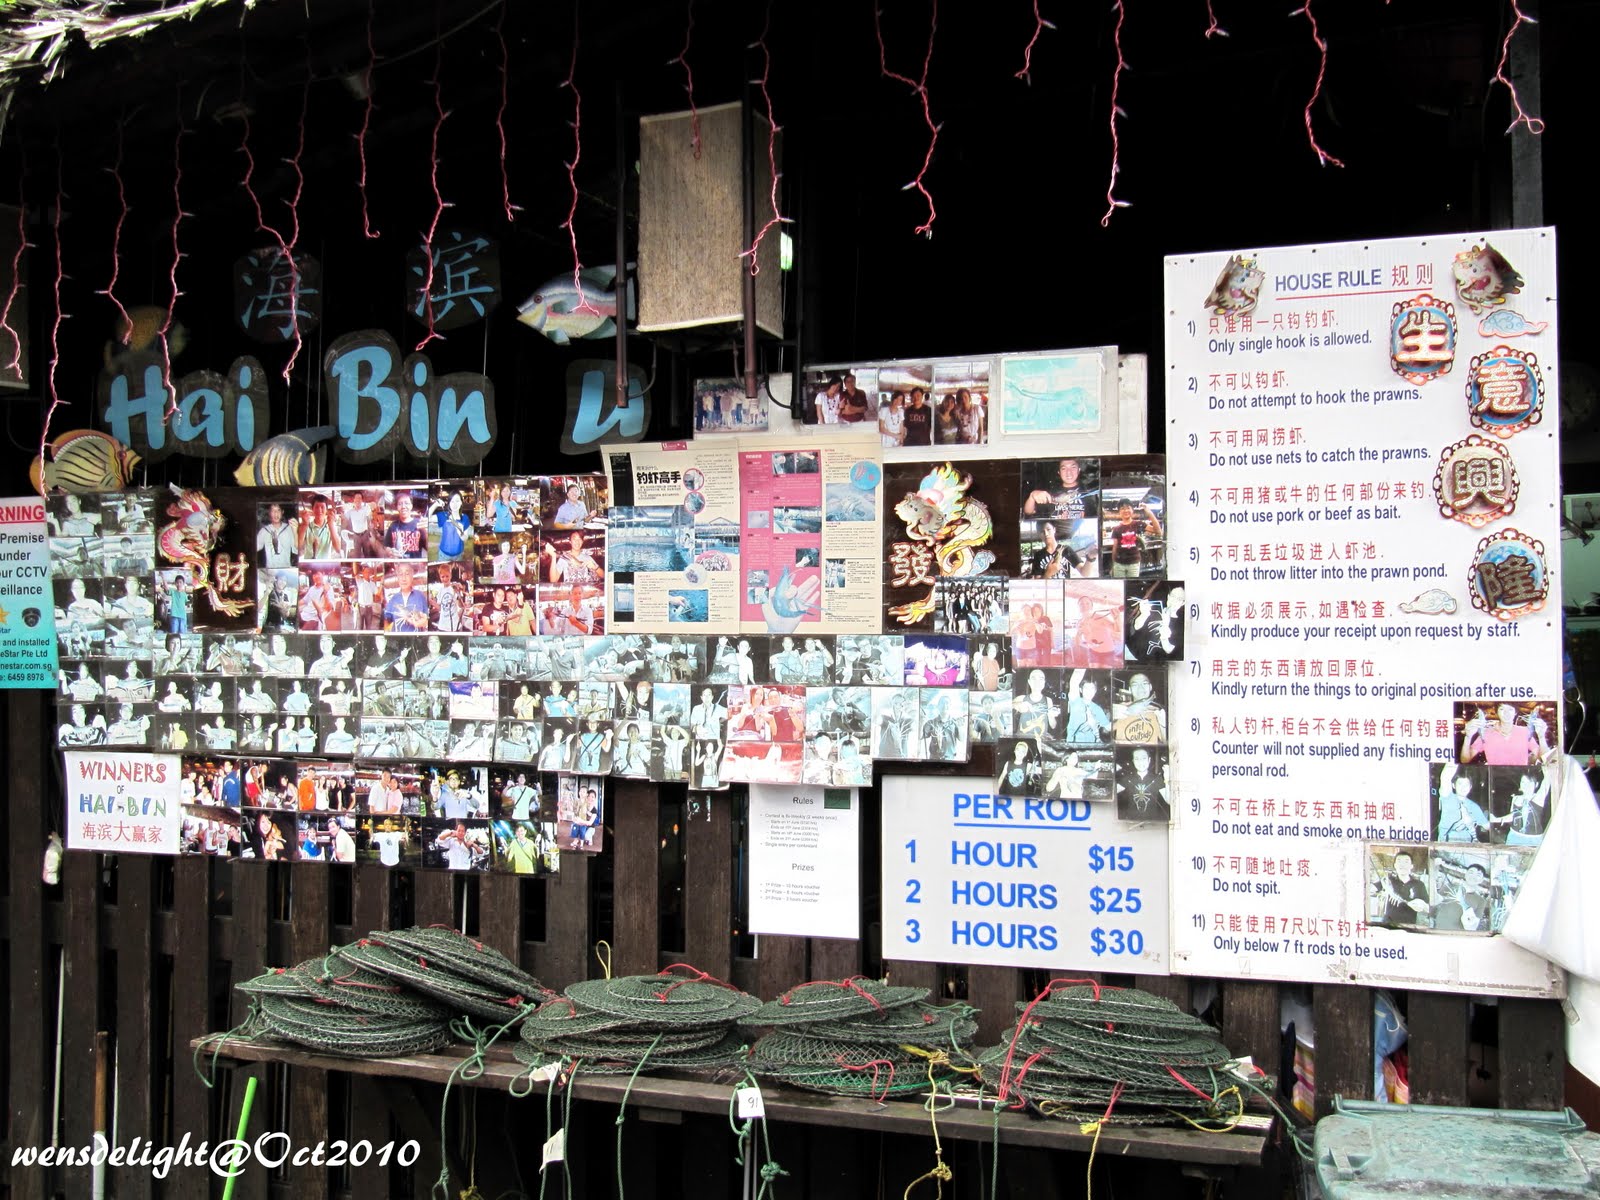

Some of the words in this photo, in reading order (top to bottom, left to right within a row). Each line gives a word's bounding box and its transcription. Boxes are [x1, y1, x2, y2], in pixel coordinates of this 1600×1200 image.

[243, 251, 319, 338] 海
[413, 232, 494, 331] 滨
[1276, 272, 1332, 292] HOUSE
[1338, 269, 1381, 287] RULE
[1392, 263, 1432, 286] 规则
[1188, 320, 1195, 337] 1)
[1396, 310, 1453, 362] 生
[1209, 339, 1235, 355] Only
[1239, 336, 1272, 353] single
[1276, 334, 1305, 348] hook
[1310, 333, 1319, 346] is
[1324, 330, 1371, 346] allowed.
[1188, 377, 1197, 393] 2)
[104, 364, 255, 452] Hai
[331, 345, 492, 452] Bin
[1209, 396, 1224, 409] Do
[1229, 396, 1247, 408] not
[1251, 393, 1296, 409] attempt
[1300, 392, 1312, 405] to
[1316, 390, 1346, 404] hook
[1351, 389, 1369, 402] the
[1374, 389, 1422, 405] prawns.
[1189, 434, 1198, 450] 3)
[1210, 453, 1225, 466] Do
[1229, 453, 1247, 465] not
[1252, 454, 1272, 465] use
[1276, 451, 1301, 464] nets
[1306, 450, 1317, 463] to
[1322, 448, 1355, 462] catch
[1359, 447, 1378, 461] the
[1382, 448, 1430, 463] prawns.
[637, 471, 681, 484] 钓虾高手
[1189, 490, 1199, 507] 4)
[1210, 510, 1226, 523] Do
[1230, 510, 1248, 523] not
[1252, 512, 1273, 522] use
[1277, 508, 1303, 525] pork
[1309, 511, 1321, 521] or
[1325, 506, 1352, 520] beef
[1357, 509, 1370, 519] as
[1375, 505, 1400, 519] bait.
[0, 533, 44, 543] Premise
[0, 550, 31, 561] under
[888, 541, 935, 588] 發
[1190, 547, 1199, 563] 5)
[16, 566, 47, 578] CCTV
[1211, 567, 1226, 580] Do
[1231, 568, 1249, 580] not
[1253, 566, 1286, 580] throw
[1290, 566, 1317, 579] litter
[1322, 565, 1343, 579] into
[1348, 565, 1367, 578] the
[1371, 567, 1409, 582] prawn
[1413, 563, 1447, 580] pond.
[1190, 604, 1199, 620] 6)
[1212, 624, 1247, 641] Kindly
[1251, 624, 1299, 641] produce
[1304, 627, 1330, 641] your
[1335, 624, 1376, 640] receipt
[1381, 627, 1411, 640] upon
[1415, 624, 1463, 640] request
[1468, 623, 1482, 640] by
[1487, 622, 1519, 637] staff.
[8, 673, 24, 681] 6459
[1191, 661, 1201, 677] 7)
[1212, 681, 1247, 699] Kindly
[1252, 683, 1287, 695] return
[1291, 682, 1309, 695] the
[1314, 682, 1350, 699] things
[1355, 683, 1367, 696] to
[1371, 683, 1416, 700] original
[1421, 684, 1471, 700] position
[1476, 683, 1506, 697] after
[1511, 687, 1536, 698] use.
[1191, 718, 1200, 735] 8)
[1212, 740, 1258, 754] Counter
[1263, 741, 1281, 755] will
[1286, 743, 1304, 755] not
[1309, 743, 1359, 759] supplied
[1363, 747, 1385, 761] any
[1389, 743, 1431, 762] fishing
[79, 760, 167, 783] WINNERS
[1213, 763, 1262, 779] personal
[1267, 763, 1288, 777] rod.
[117, 785, 125, 794] OF
[793, 797, 813, 805] Rules
[954, 794, 1013, 819] PER
[1025, 799, 1091, 821] ROD
[1191, 799, 1200, 815] 9)
[83, 820, 163, 843] 海滨大赢家
[1213, 820, 1228, 834] Do
[1232, 822, 1251, 835] not
[1255, 823, 1273, 835] eat
[1278, 823, 1299, 836] and
[1303, 824, 1342, 838] smoke
[1347, 828, 1364, 840] on
[1365, 825, 1387, 841] the
[905, 839, 916, 863] 1
[952, 841, 1038, 868] HOUR
[1089, 844, 1134, 873] $15
[1192, 856, 1206, 873] 10)
[792, 863, 814, 871] Prizes
[906, 879, 921, 903] 2
[952, 880, 1057, 910] HOURS
[1090, 886, 1141, 915] $25
[1213, 878, 1229, 892] Do
[1233, 880, 1251, 893] not
[1256, 881, 1280, 897] spit.
[1192, 914, 1205, 931] 11)
[906, 919, 920, 943] 3
[952, 921, 1057, 951] HOURS
[1091, 927, 1143, 956] $30
[1214, 936, 1240, 954] Only
[1245, 937, 1279, 952] below
[1283, 939, 1290, 953] 7
[1294, 940, 1303, 954] ft
[1308, 942, 1335, 955] rods
[1339, 943, 1351, 956] to
[1355, 943, 1370, 957] be
[1374, 946, 1407, 960] used.
